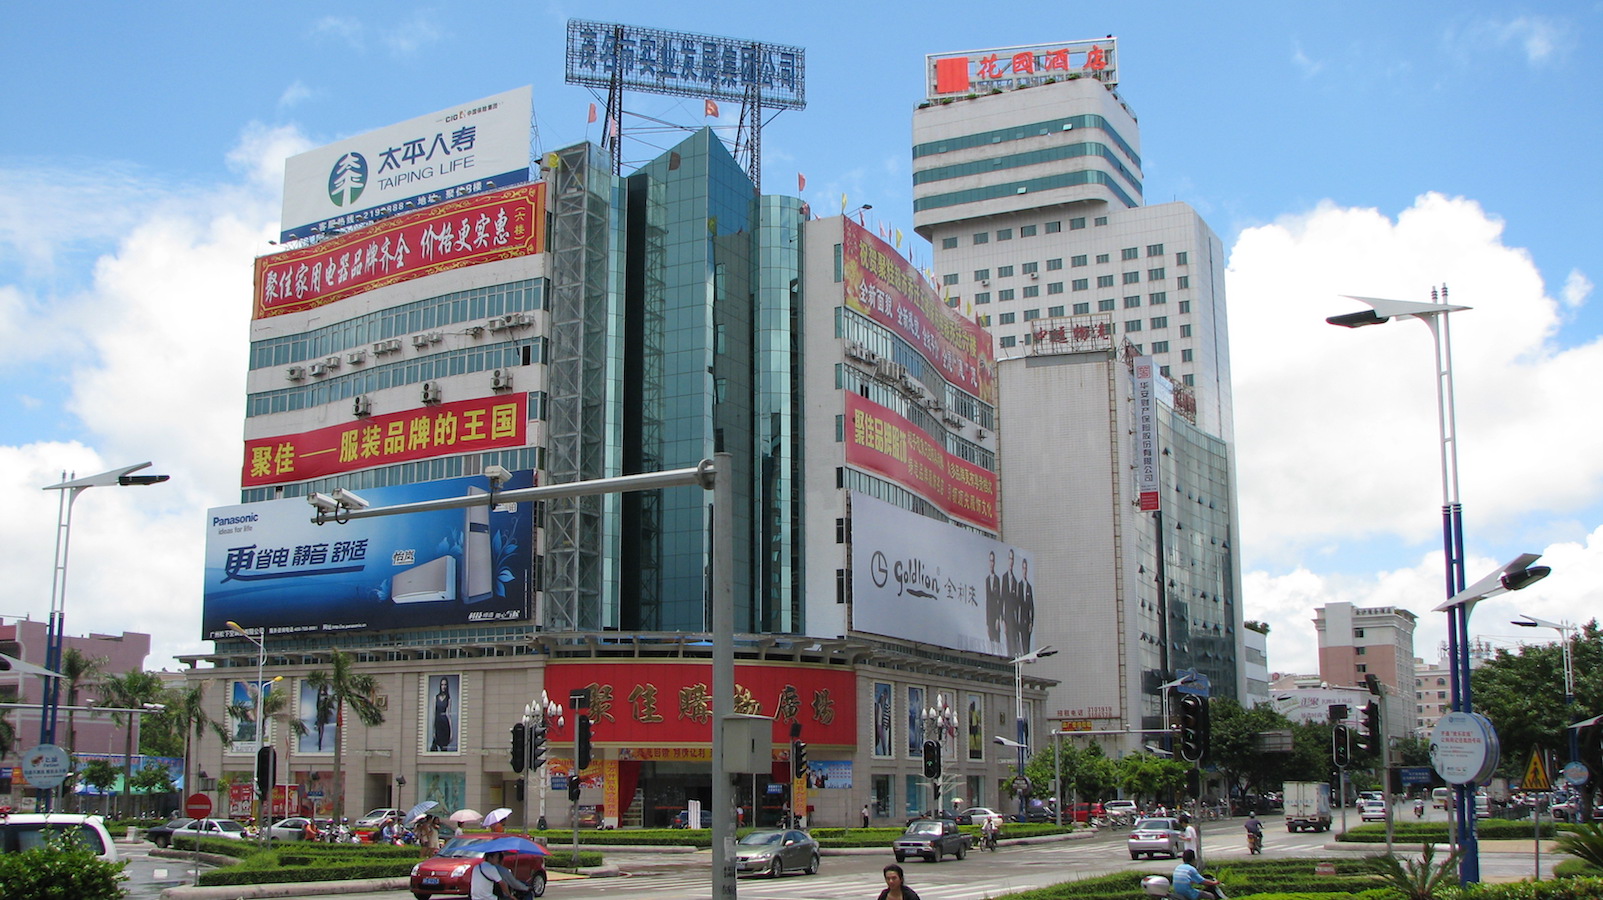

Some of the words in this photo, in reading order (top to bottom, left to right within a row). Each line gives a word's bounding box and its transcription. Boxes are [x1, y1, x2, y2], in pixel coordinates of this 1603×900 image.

[977, 45, 1108, 79] 花园酒店
[378, 126, 476, 174] 太平人寿
[378, 165, 434, 191] TAIPING
[440, 155, 475, 175] LIFE
[264, 232, 411, 304] 聚佳家用电器品牌齐全
[420, 206, 510, 260] 价格更实惠
[213, 512, 259, 527] Panasonic
[220, 543, 291, 584] 更省电
[292, 543, 329, 567] 静音
[331, 538, 369, 564] 舒适
[894, 558, 940, 597] goldlion
